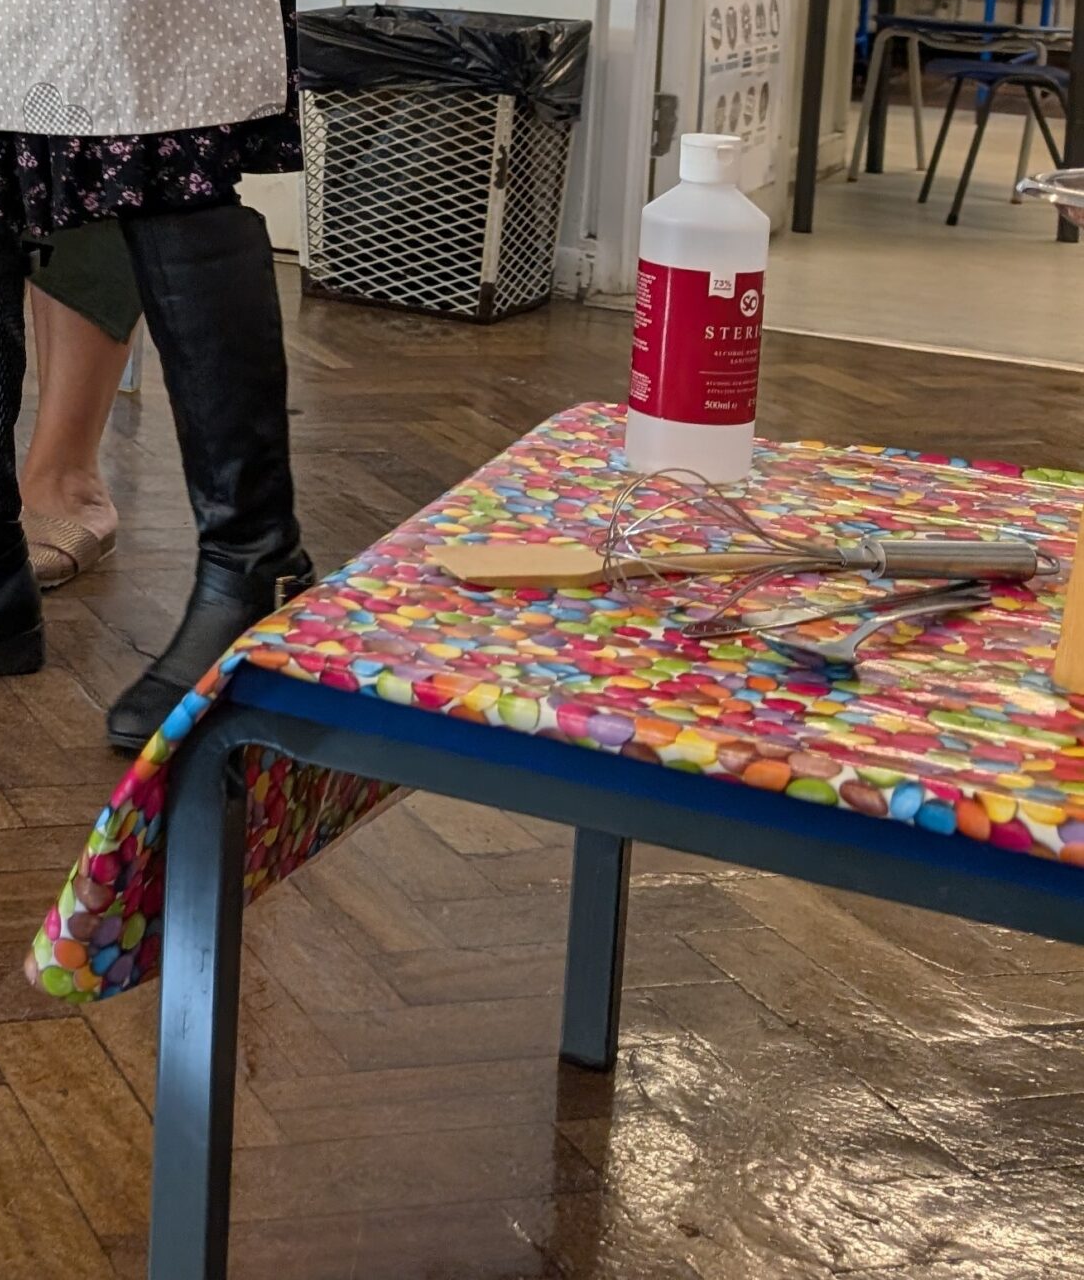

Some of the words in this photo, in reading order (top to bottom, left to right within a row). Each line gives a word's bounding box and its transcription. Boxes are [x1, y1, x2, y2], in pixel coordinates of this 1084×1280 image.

[713, 280, 732, 288] 73%
[742, 295, 757, 312] SO
[704, 324, 762, 341] STERI
[704, 400, 731, 410] 500ml
